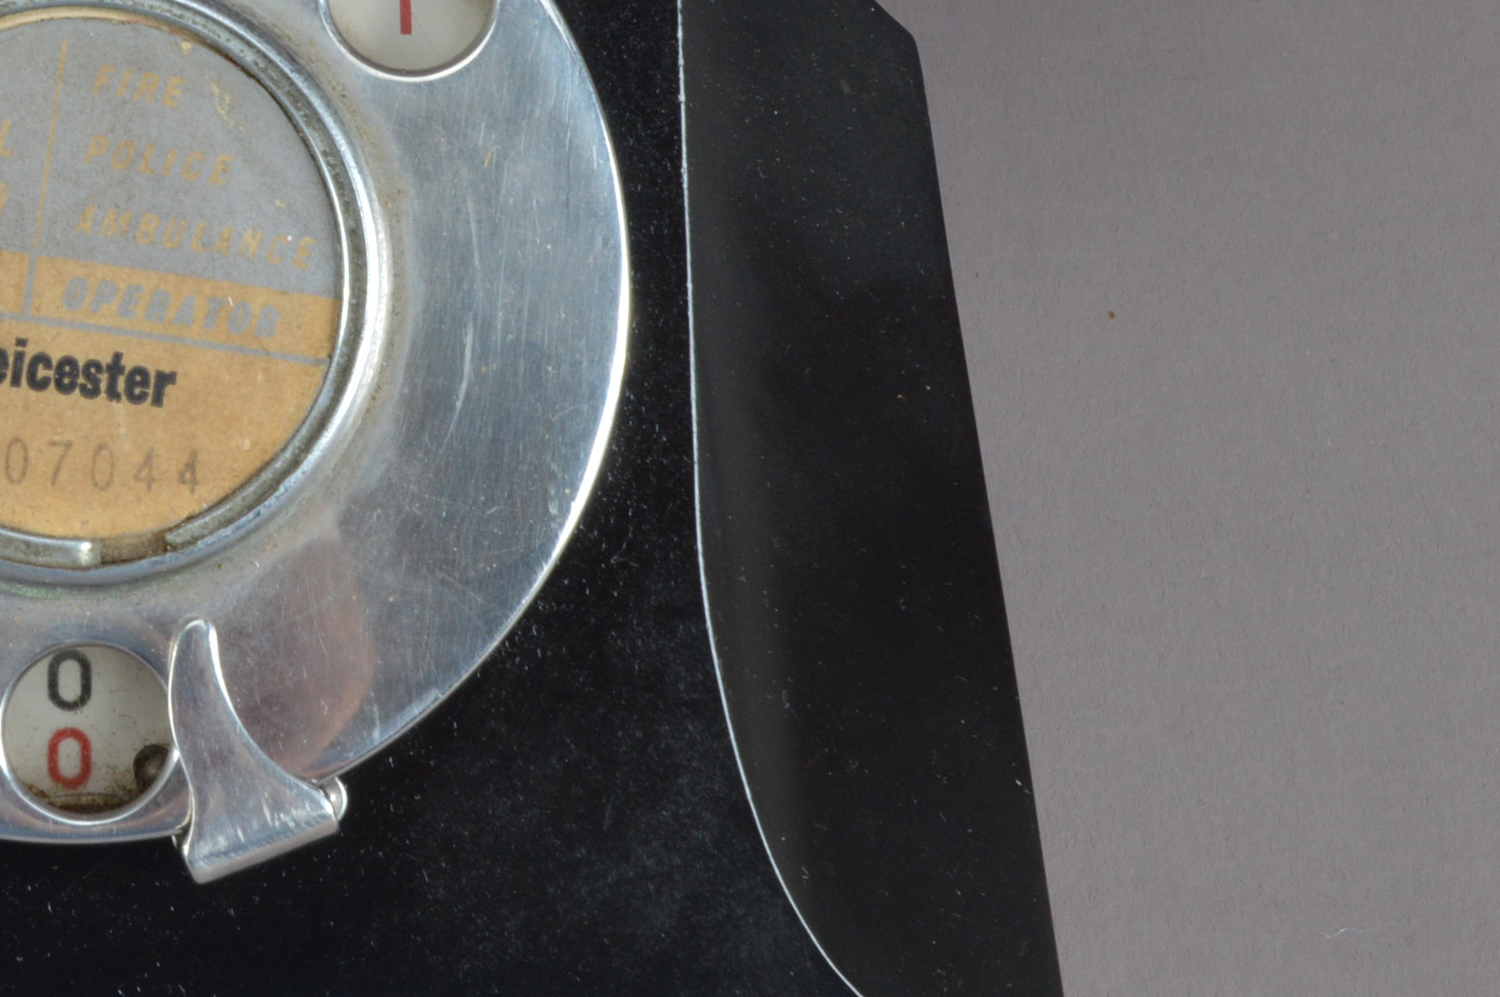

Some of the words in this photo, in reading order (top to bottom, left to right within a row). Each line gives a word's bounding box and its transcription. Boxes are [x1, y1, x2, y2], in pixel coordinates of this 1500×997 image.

[92, 65, 188, 110] FIRE
[84, 135, 236, 186] POLICE
[74, 204, 318, 270] AMBULANCE
[61, 276, 280, 340] OPERATOR
